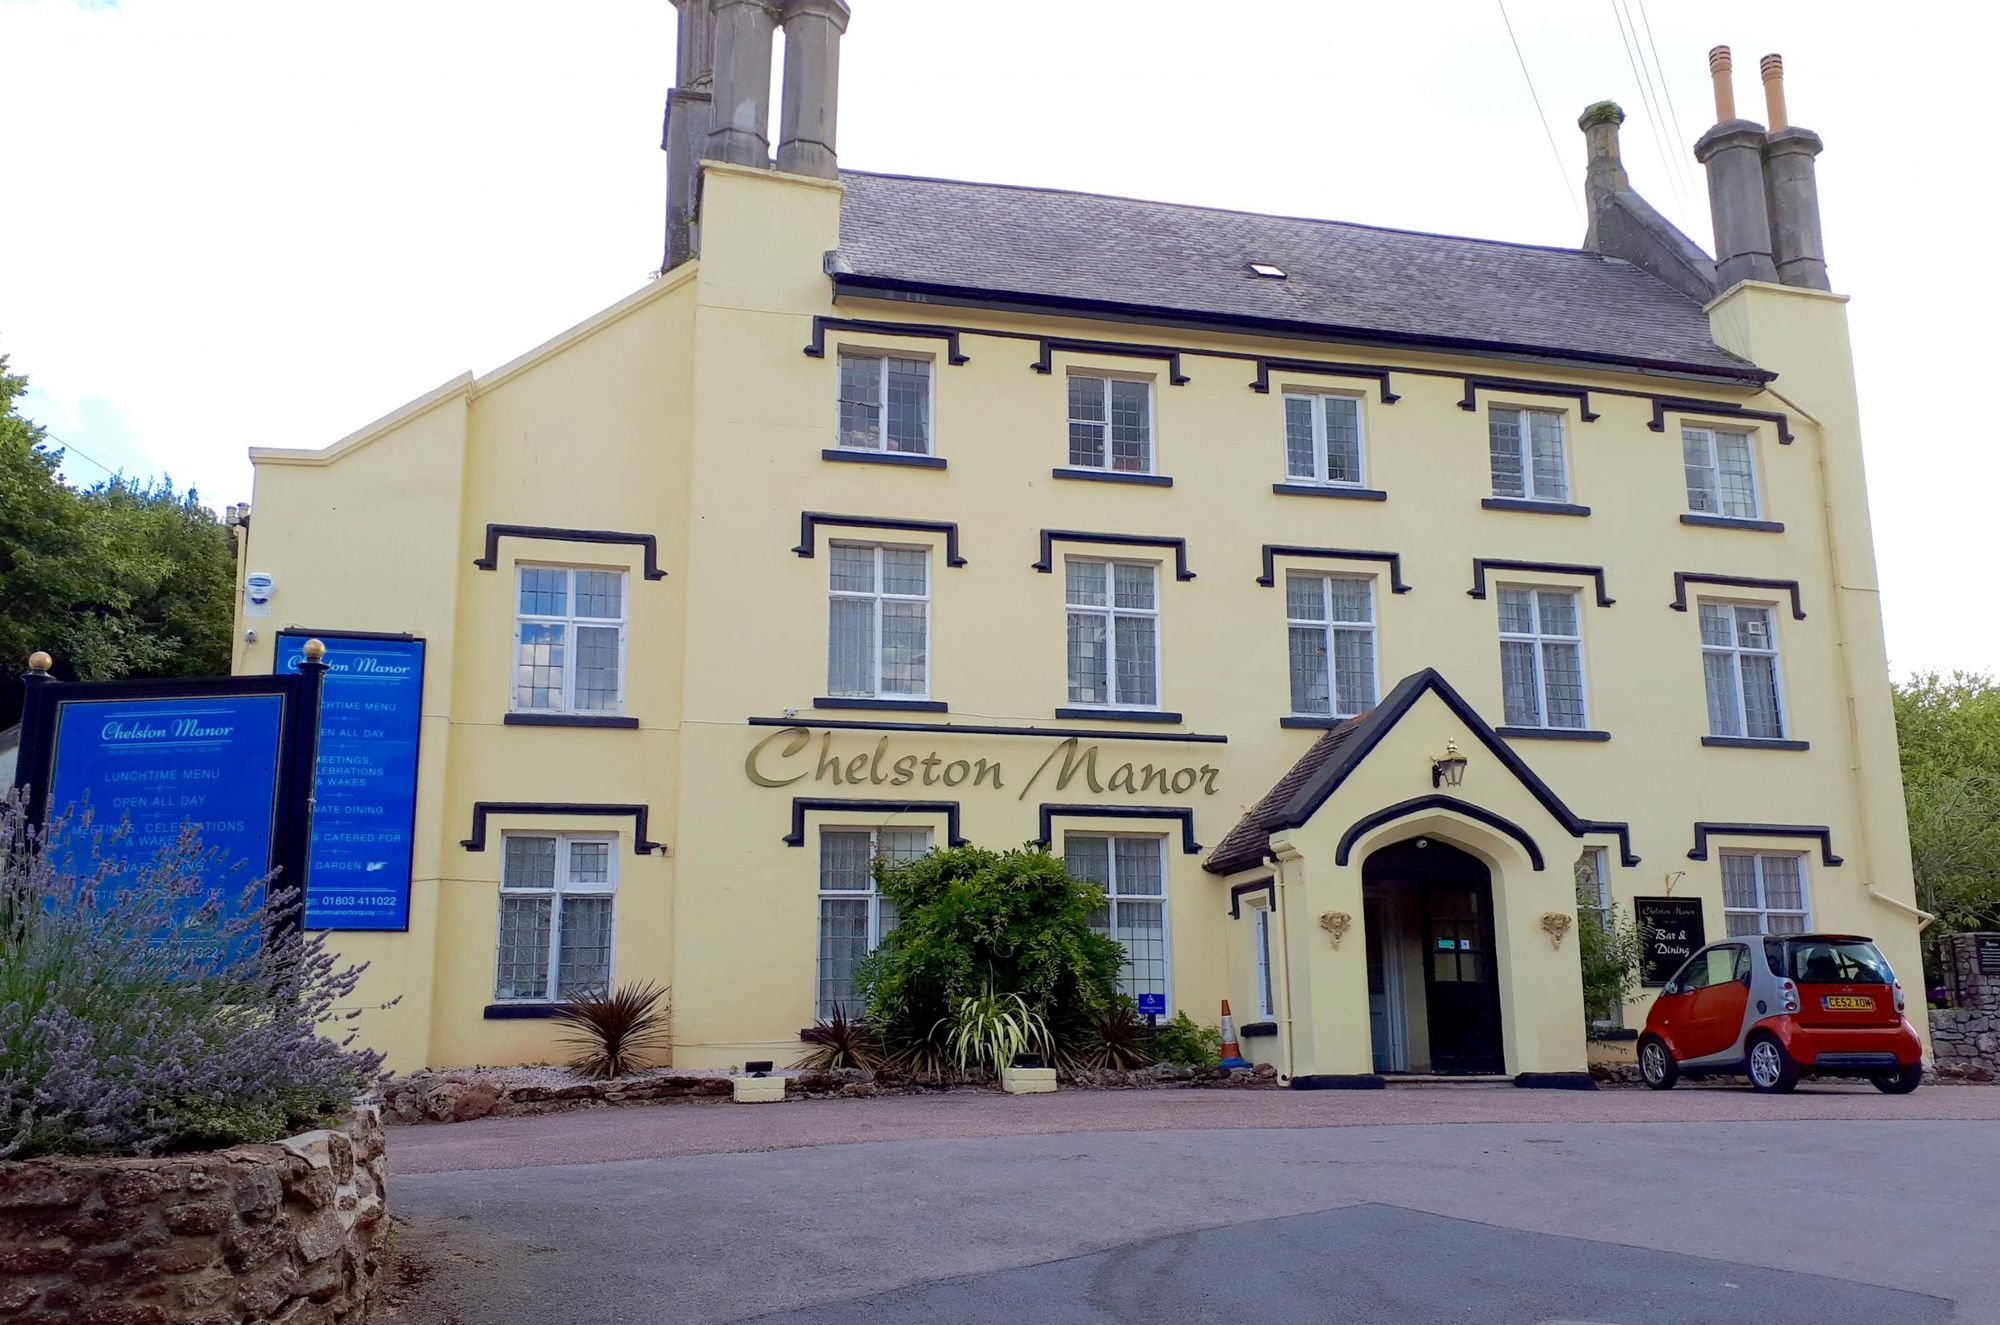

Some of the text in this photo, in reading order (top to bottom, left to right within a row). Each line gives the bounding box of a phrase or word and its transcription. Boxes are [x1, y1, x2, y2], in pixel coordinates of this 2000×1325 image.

[353, 656, 411, 674] Manor
[364, 702, 397, 712] MENU
[101, 718, 234, 741] Chelston Manor
[339, 728, 359, 738] ALL
[363, 729, 385, 739] DAY
[745, 726, 1220, 801] Chelston Manor
[104, 768, 220, 783] LUNCHTIME MENU
[327, 778, 367, 787] WAKES
[112, 795, 206, 808] OPEN ALL DAY
[344, 806, 384, 815] DINING
[126, 834, 180, 847] & WAKE
[323, 833, 375, 842] CATERED
[378, 833, 402, 843] FOR
[315, 861, 361, 871] GARDEN
[322, 896, 355, 906] 01803
[357, 896, 397, 906] 411022
[1655, 928, 1687, 940] Bar &
[1654, 942, 1690, 958] Dining
[1829, 997, 1853, 1008] CE52
